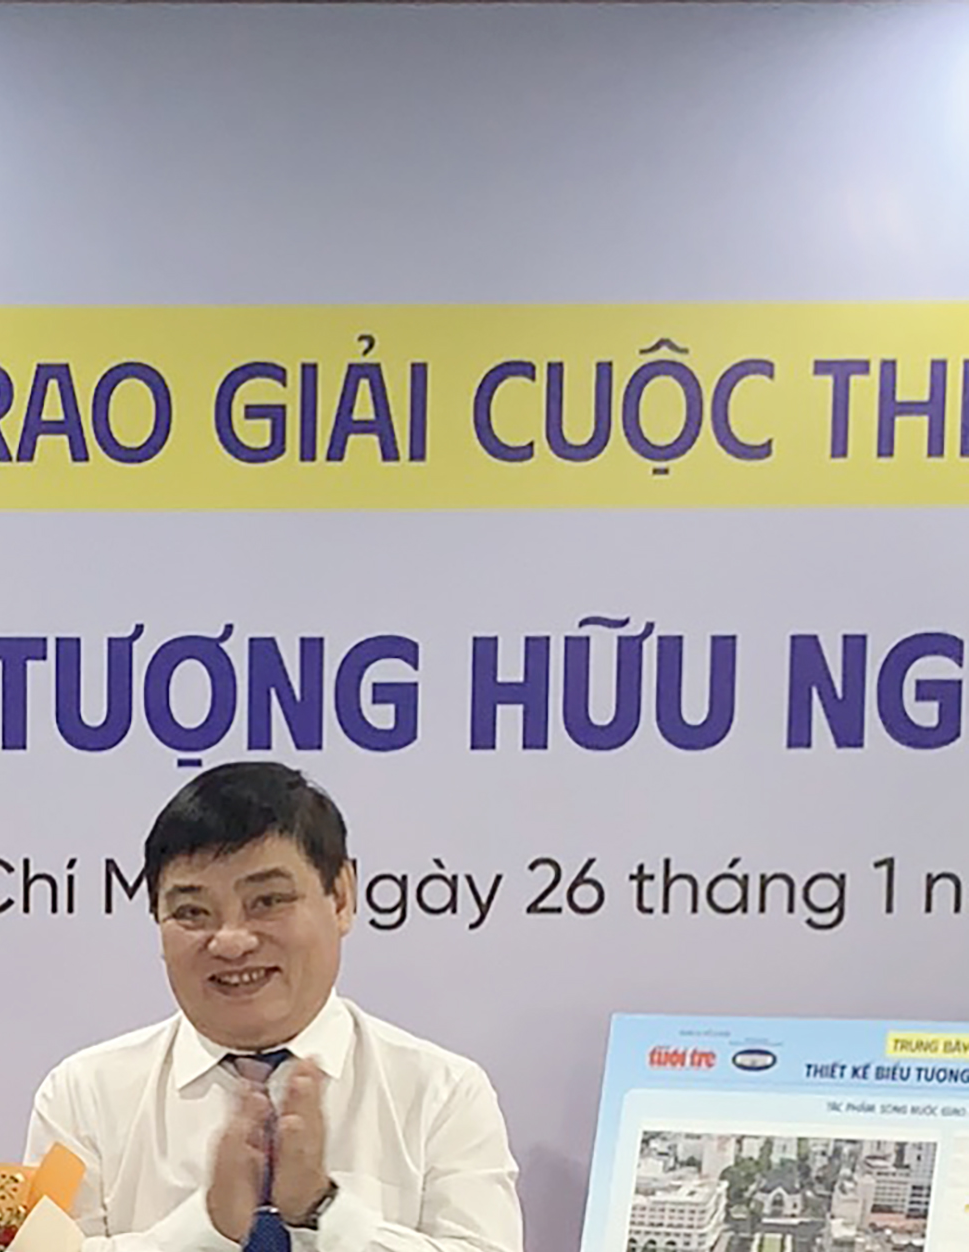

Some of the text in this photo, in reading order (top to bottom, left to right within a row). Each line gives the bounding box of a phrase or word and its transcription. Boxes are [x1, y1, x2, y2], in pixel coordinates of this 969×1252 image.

[214, 334, 428, 463] GIẢI
[473, 338, 775, 475] CUỘC
[470, 616, 737, 750] HỮU
[786, 632, 964, 750] NG
[526, 857, 606, 914] 26
[629, 857, 847, 931] tháng
[873, 857, 896, 914] 1
